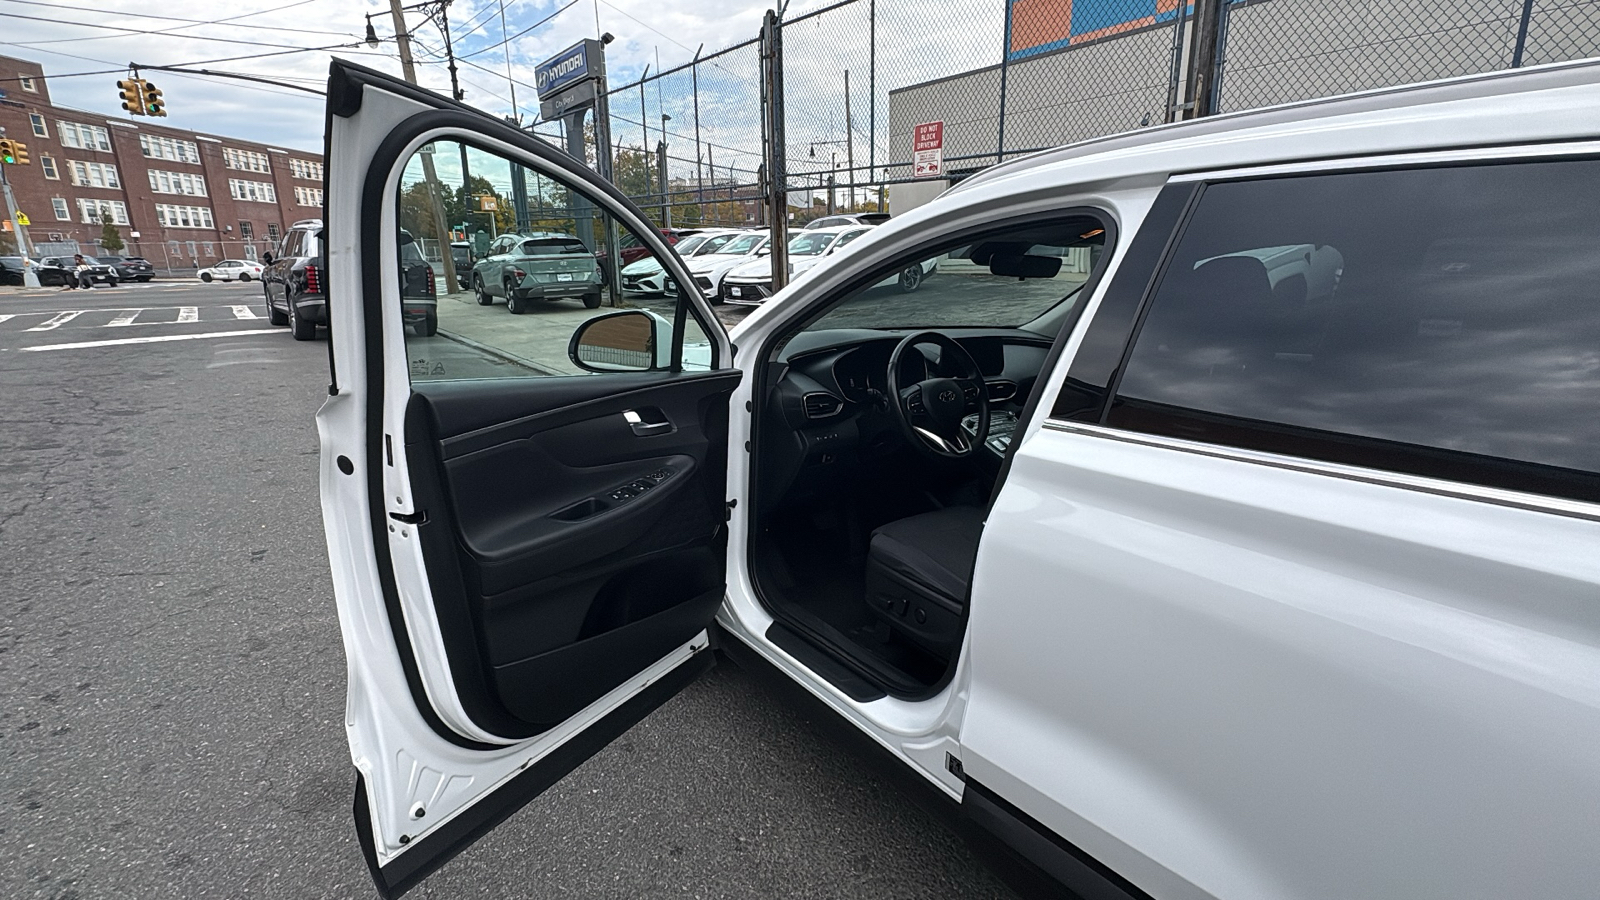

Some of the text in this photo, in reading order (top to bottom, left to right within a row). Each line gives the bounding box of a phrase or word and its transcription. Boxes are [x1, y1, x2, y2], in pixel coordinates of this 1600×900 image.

[549, 53, 583, 82] HYUNDAI
[929, 124, 938, 132] NOT
[921, 133, 936, 141] BLOCK
[917, 140, 939, 149] DRIVEWAY
